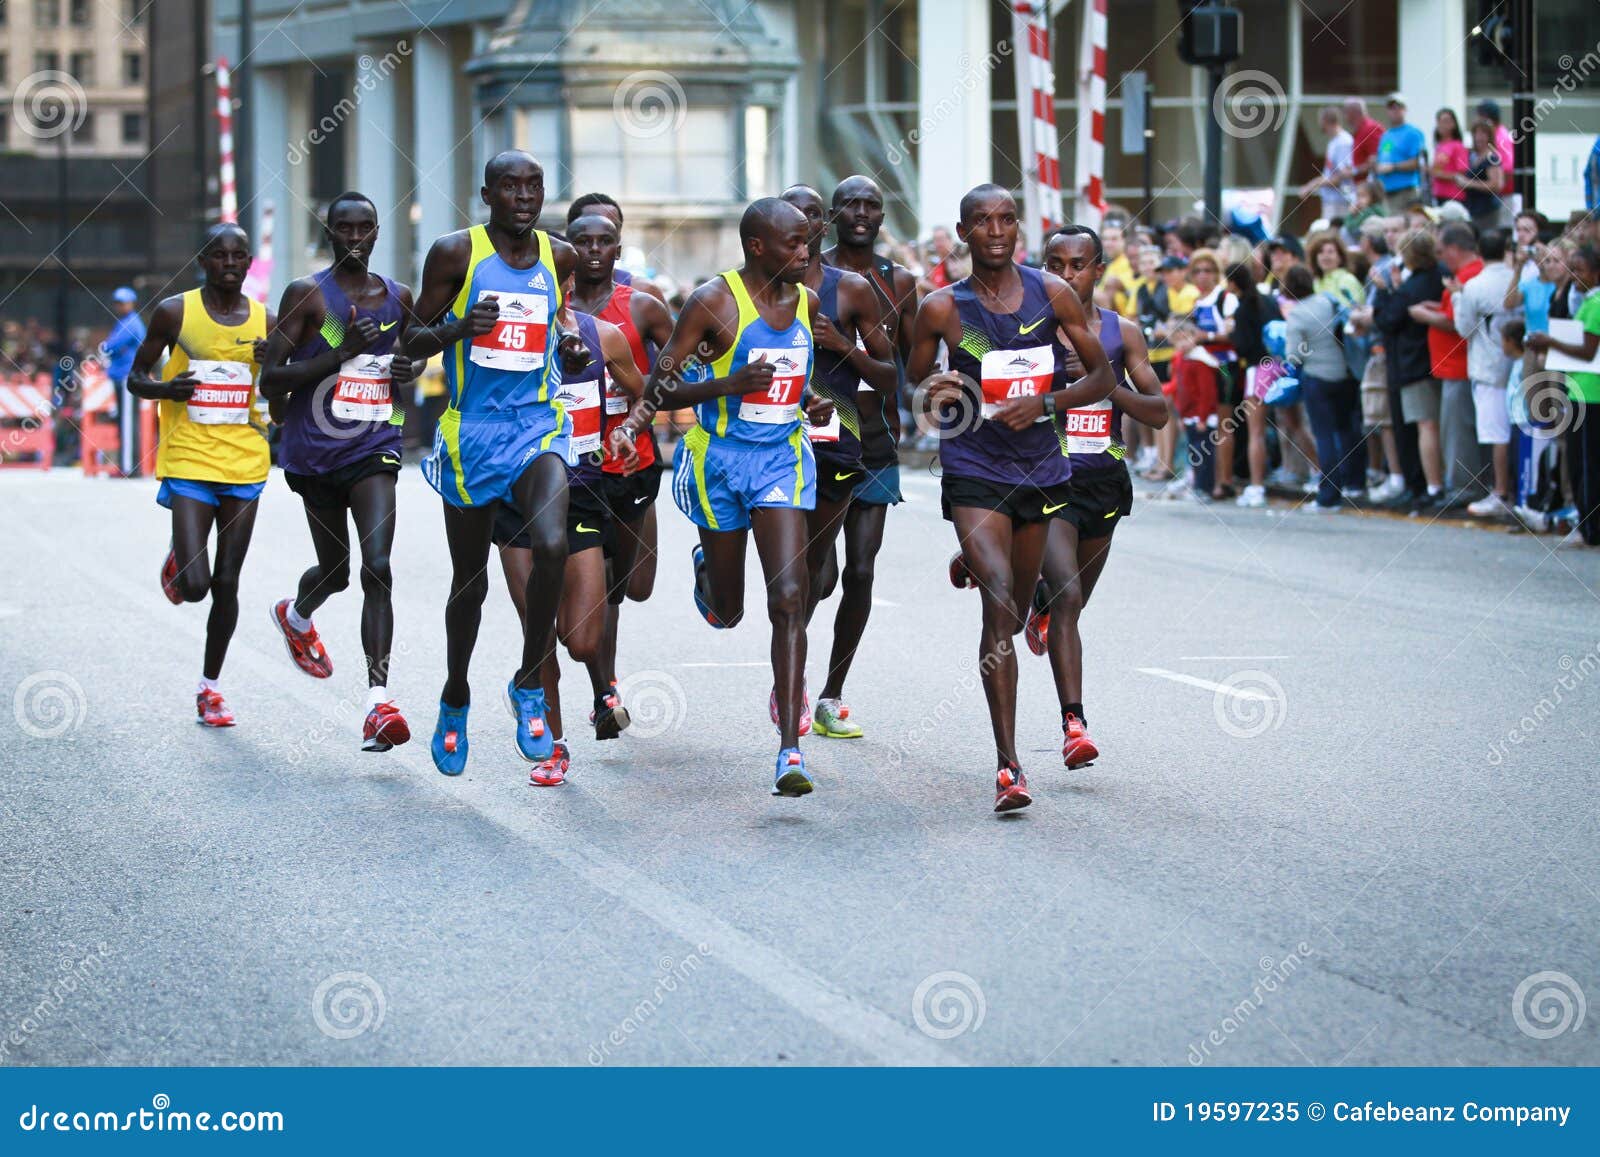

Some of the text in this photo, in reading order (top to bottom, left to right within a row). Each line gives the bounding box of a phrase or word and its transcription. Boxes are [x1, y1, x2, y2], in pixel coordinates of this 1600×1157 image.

[498, 324, 527, 349] 45
[338, 380, 390, 400] KIPRUTO
[767, 379, 793, 403] 47
[1006, 379, 1036, 399] 46
[1066, 413, 1108, 433] BEDE
